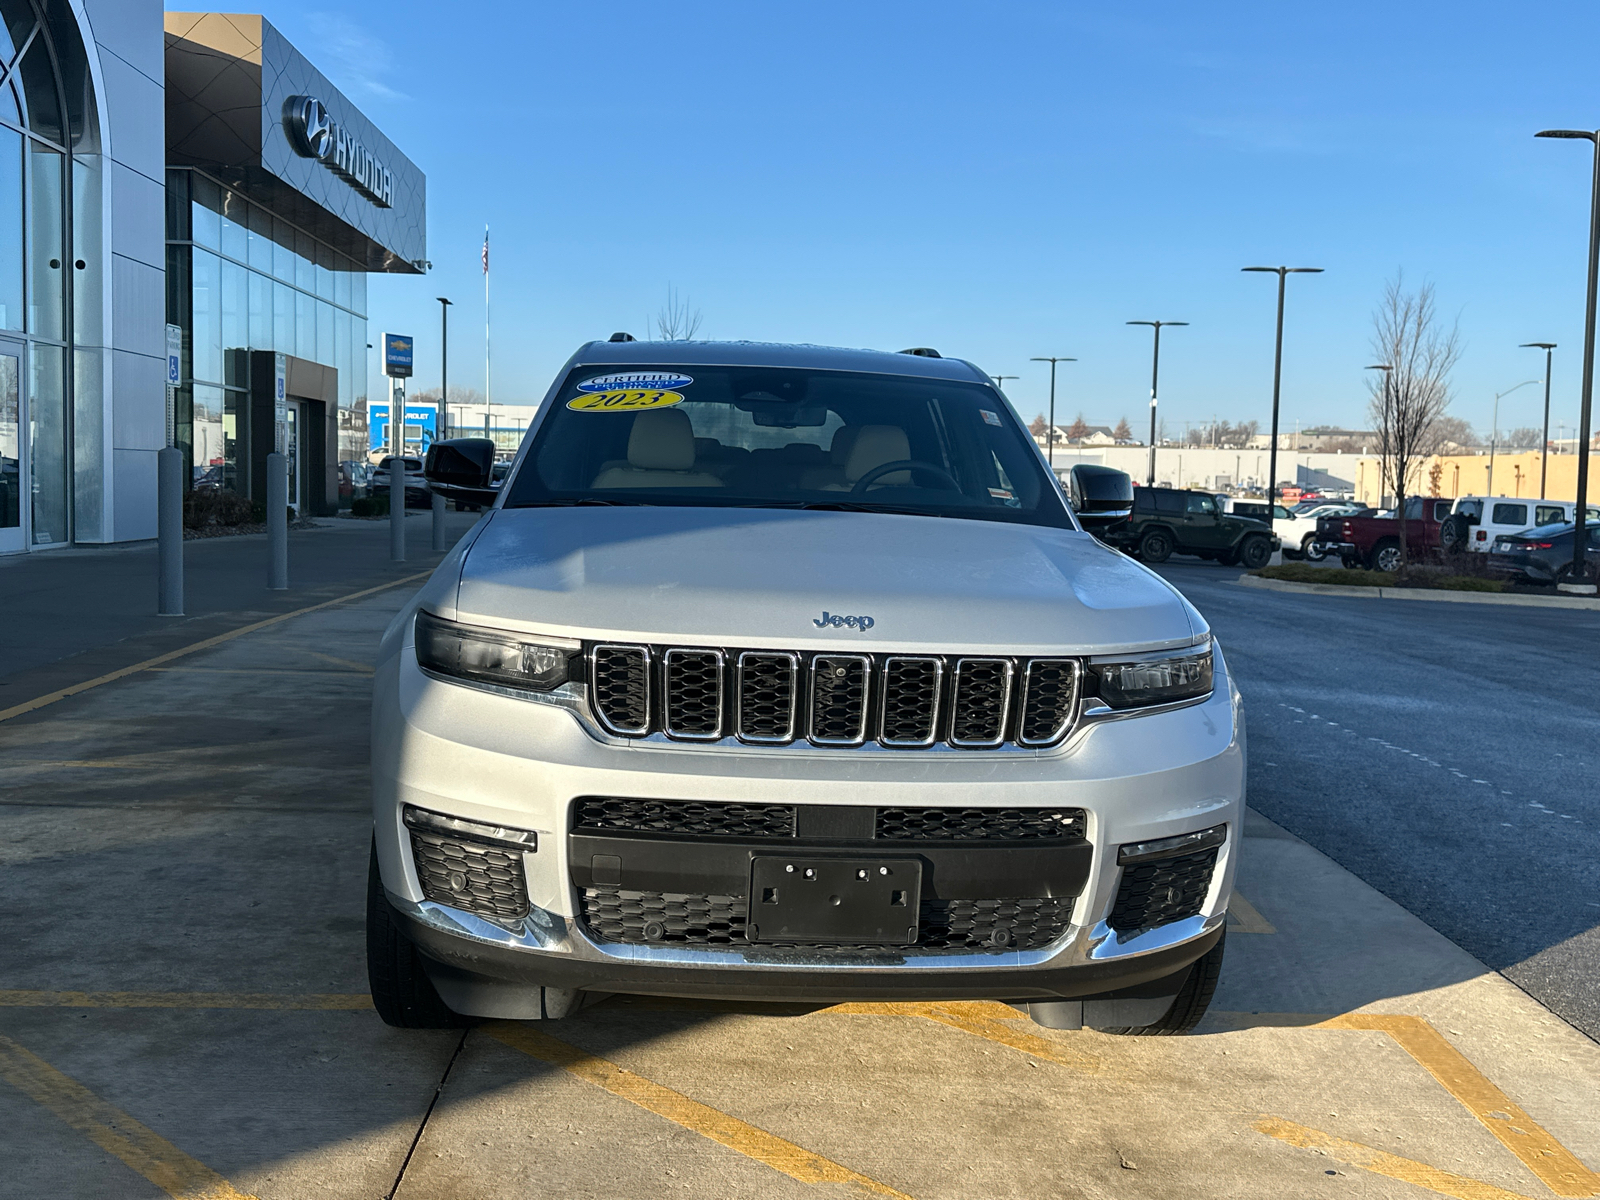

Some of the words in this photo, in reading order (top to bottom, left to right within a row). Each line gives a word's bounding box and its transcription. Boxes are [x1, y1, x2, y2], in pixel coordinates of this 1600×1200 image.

[333, 123, 395, 209] HYUNDAI
[591, 374, 681, 385] CERTIFIED
[583, 393, 665, 408] 2023
[813, 611, 874, 632] Jeep
